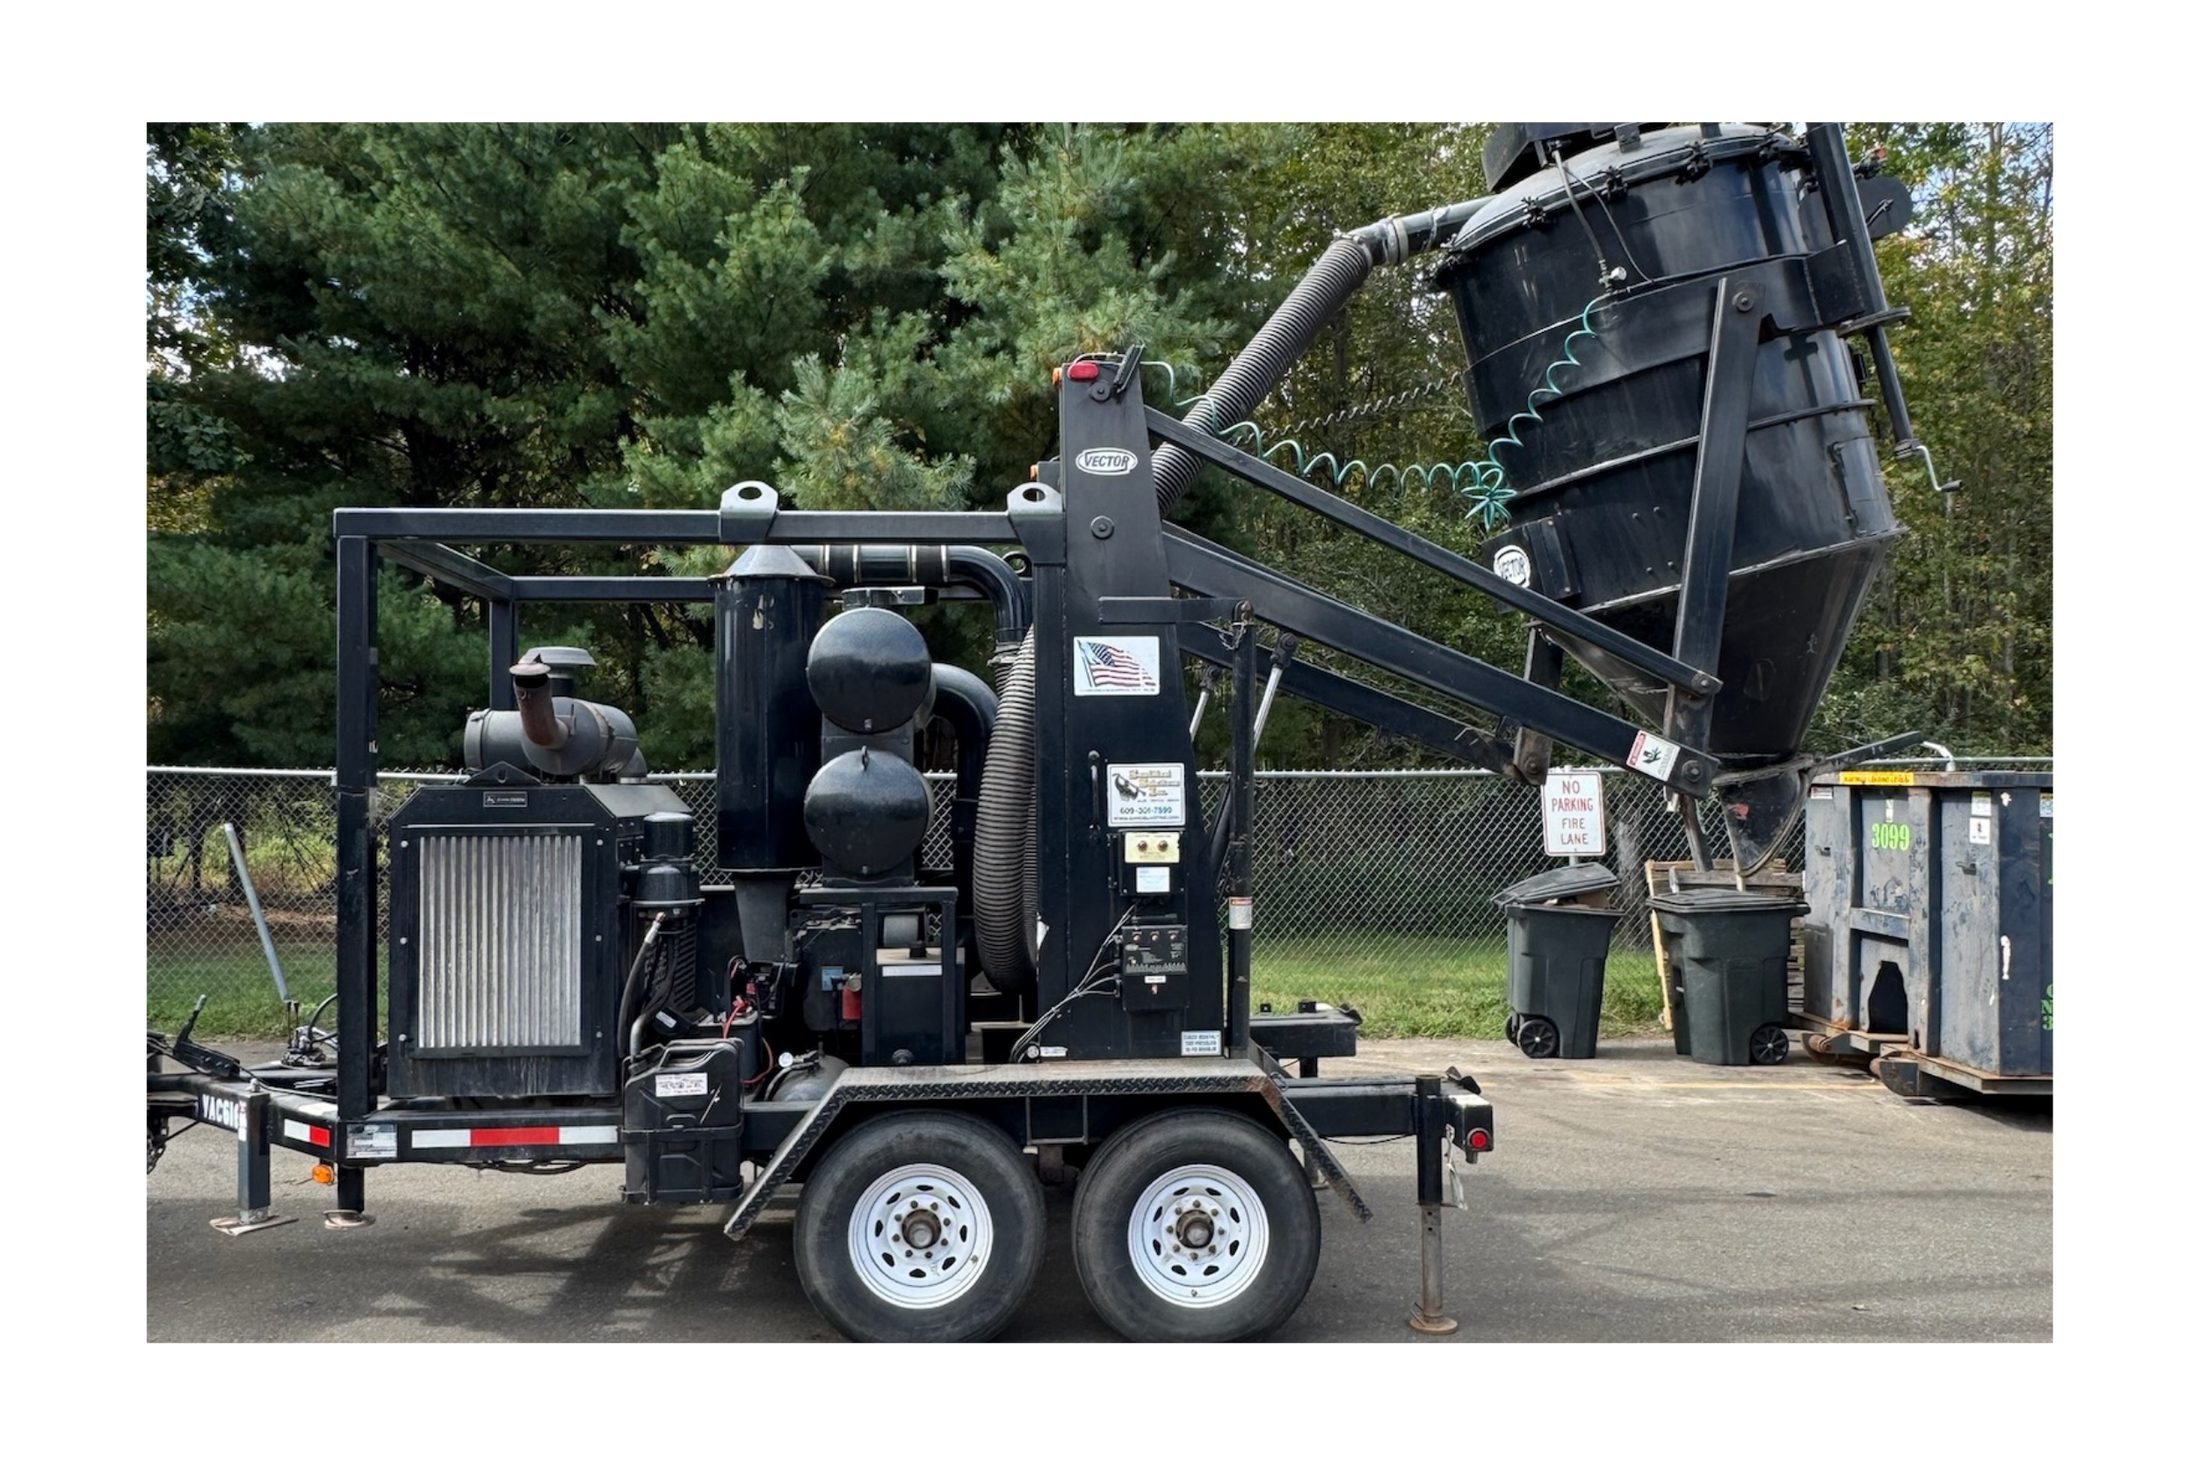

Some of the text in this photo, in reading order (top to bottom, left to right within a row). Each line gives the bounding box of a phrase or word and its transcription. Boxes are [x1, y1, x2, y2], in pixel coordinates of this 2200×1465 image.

[1084, 454, 1130, 468] VECTOR
[1562, 780, 1581, 795] NO
[1551, 797, 1594, 812] PARKING
[1562, 817, 1586, 830] FIRE
[1560, 833, 1589, 845] LANE
[1872, 823, 1910, 851] 3099
